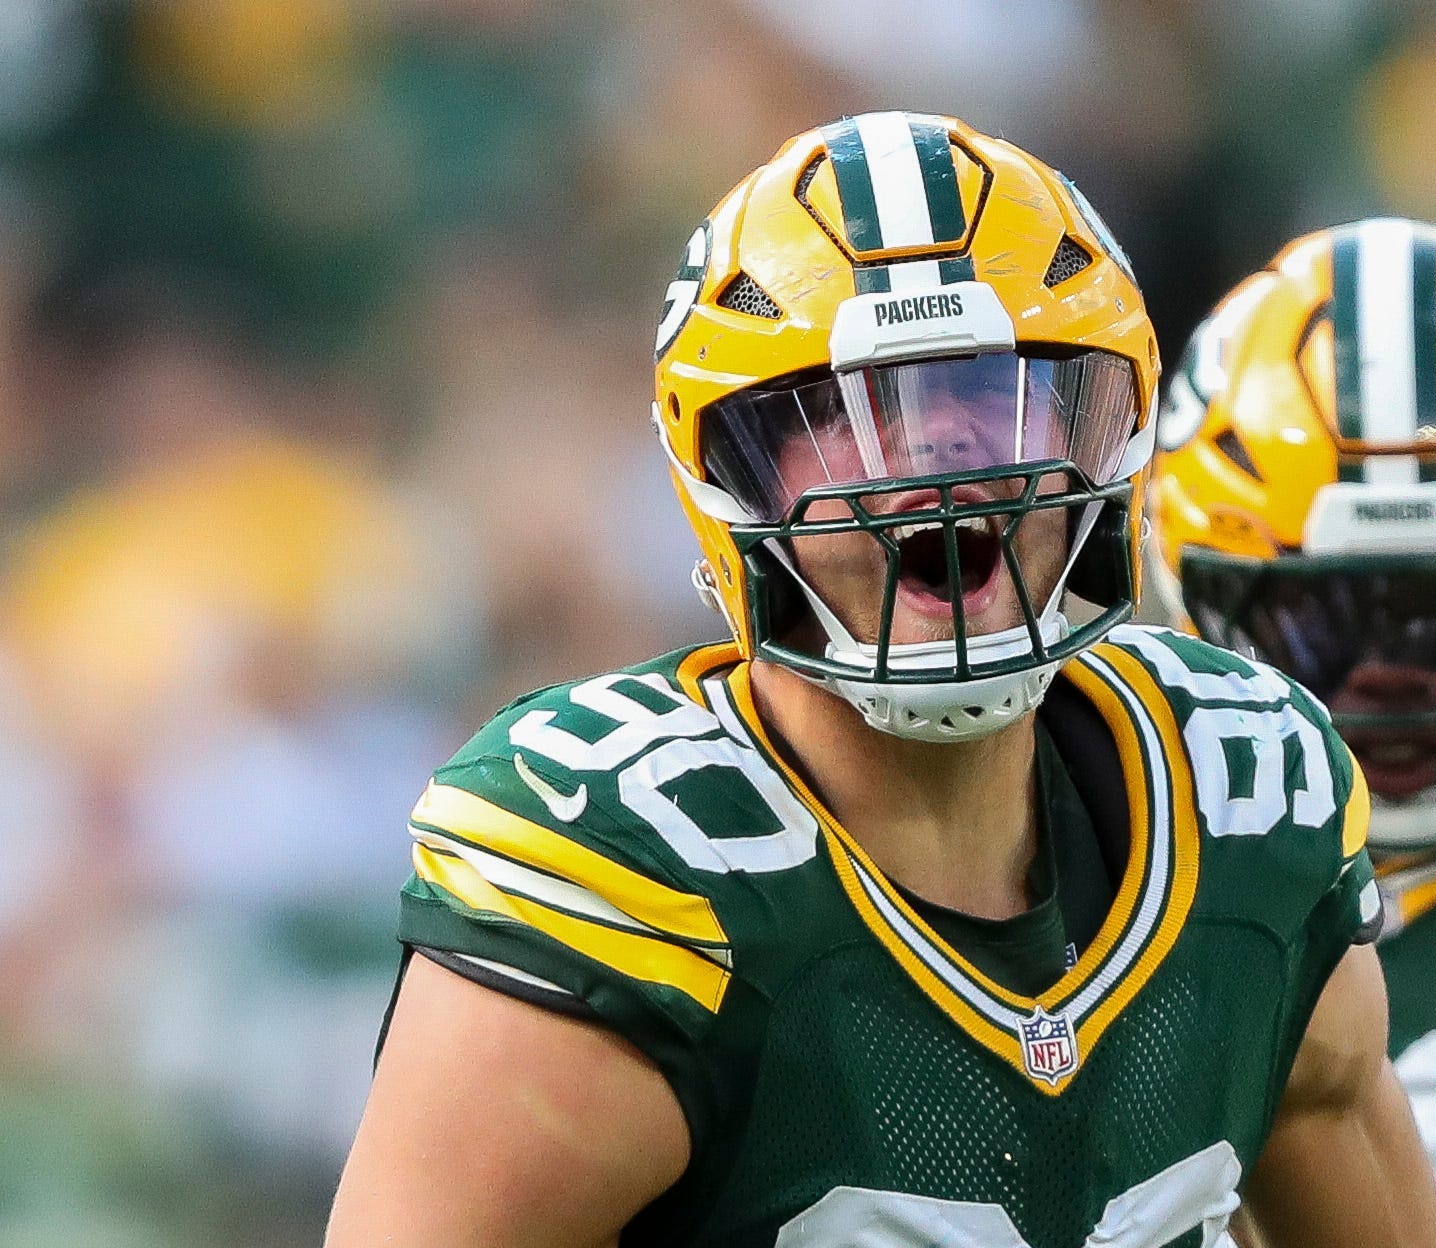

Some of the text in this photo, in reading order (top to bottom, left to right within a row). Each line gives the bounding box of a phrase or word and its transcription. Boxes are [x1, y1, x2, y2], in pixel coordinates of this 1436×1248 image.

[874, 293, 964, 327] PACKERS
[508, 673, 818, 875] 90
[1031, 1041, 1070, 1071] NFL
